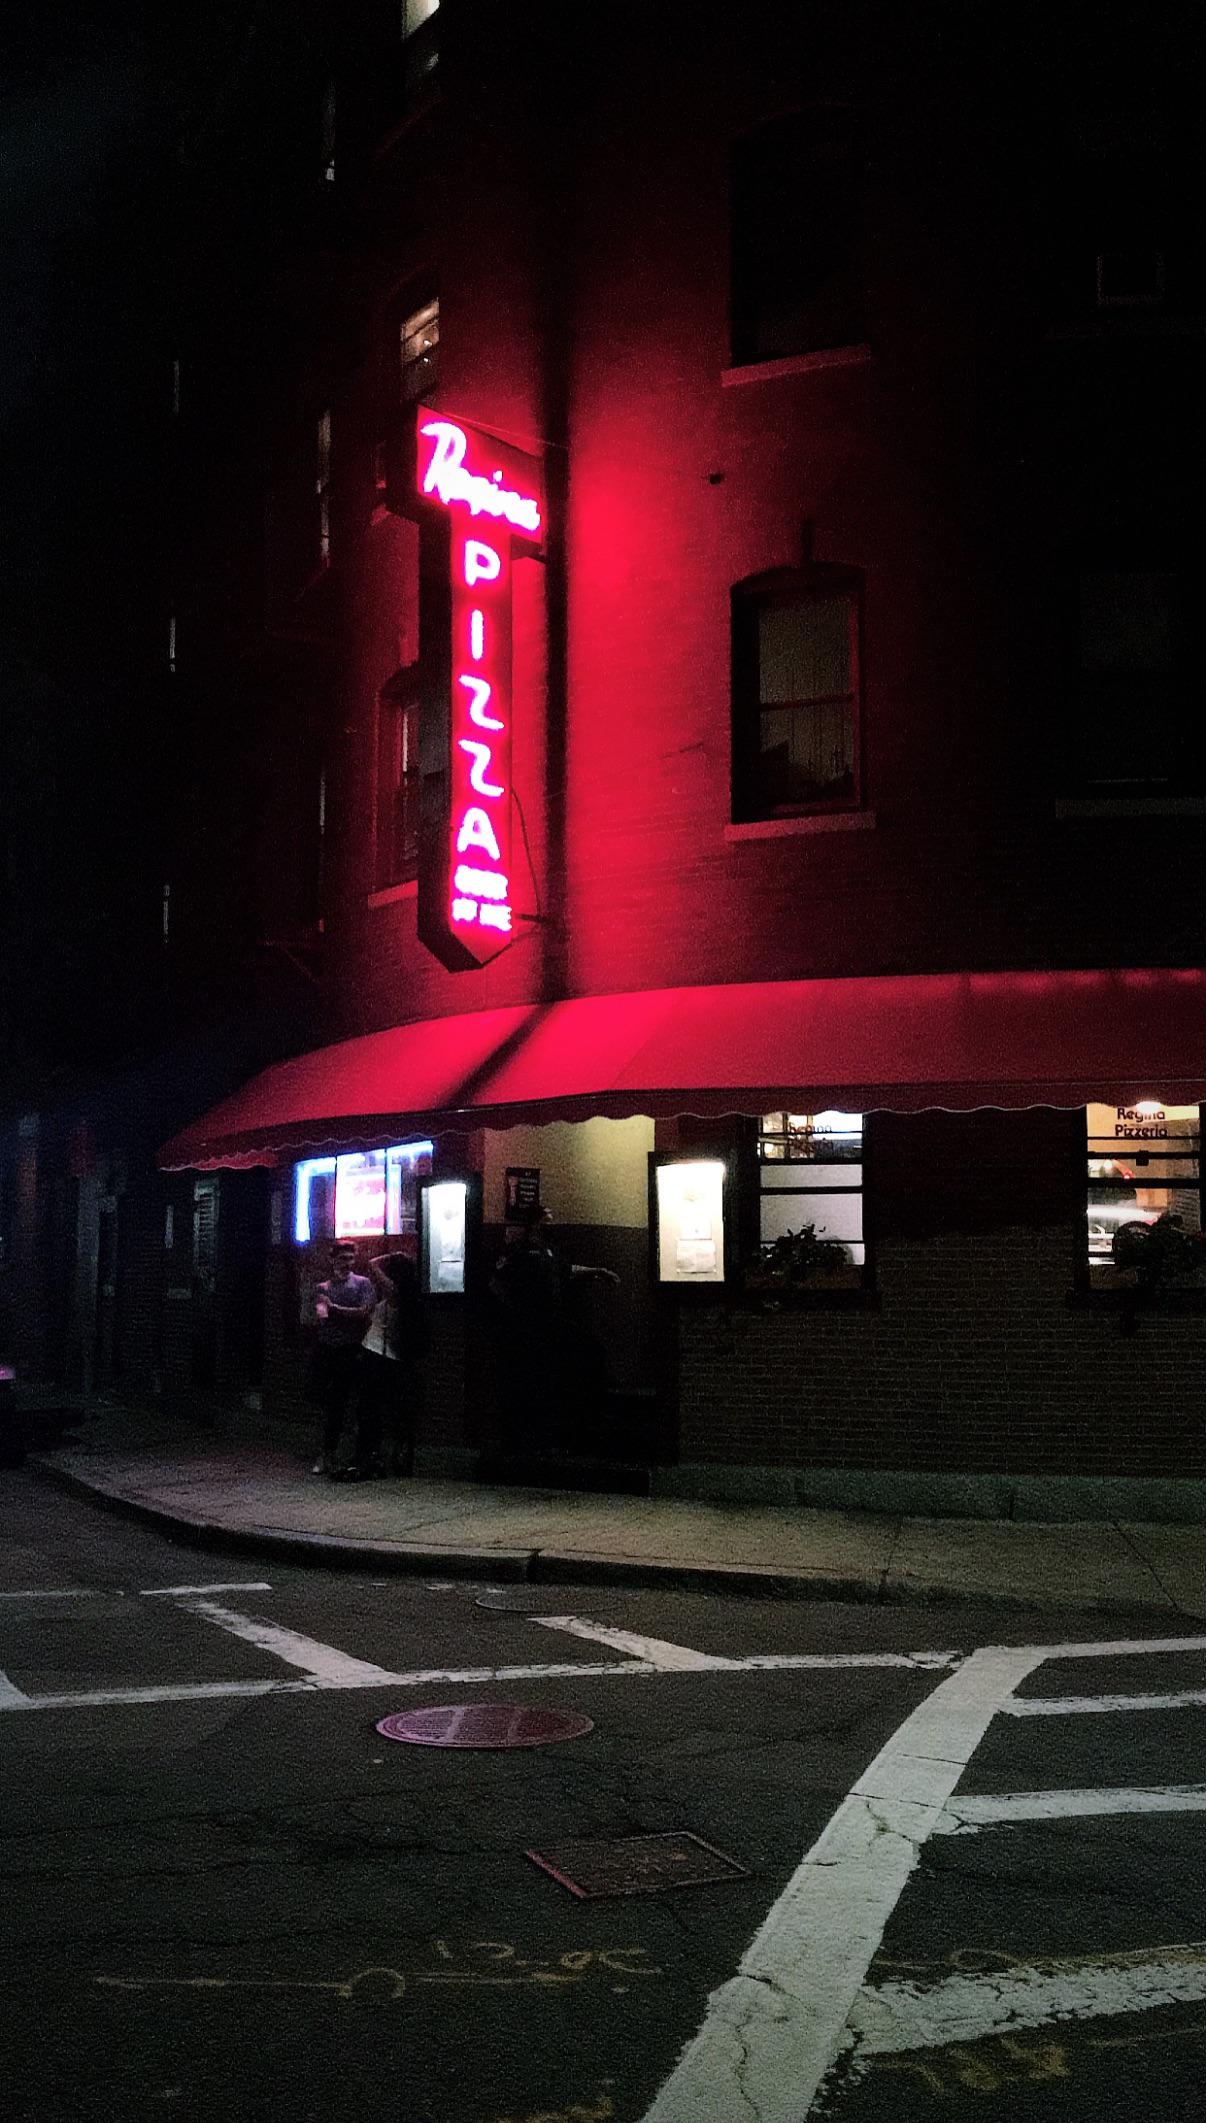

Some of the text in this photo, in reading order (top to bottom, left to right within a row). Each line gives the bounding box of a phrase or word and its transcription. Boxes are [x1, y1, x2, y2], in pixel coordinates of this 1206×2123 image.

[458, 540, 504, 861] PIZZA
[1117, 1107, 1165, 1122] Regina
[1115, 1124, 1168, 1137] Pizzeria
